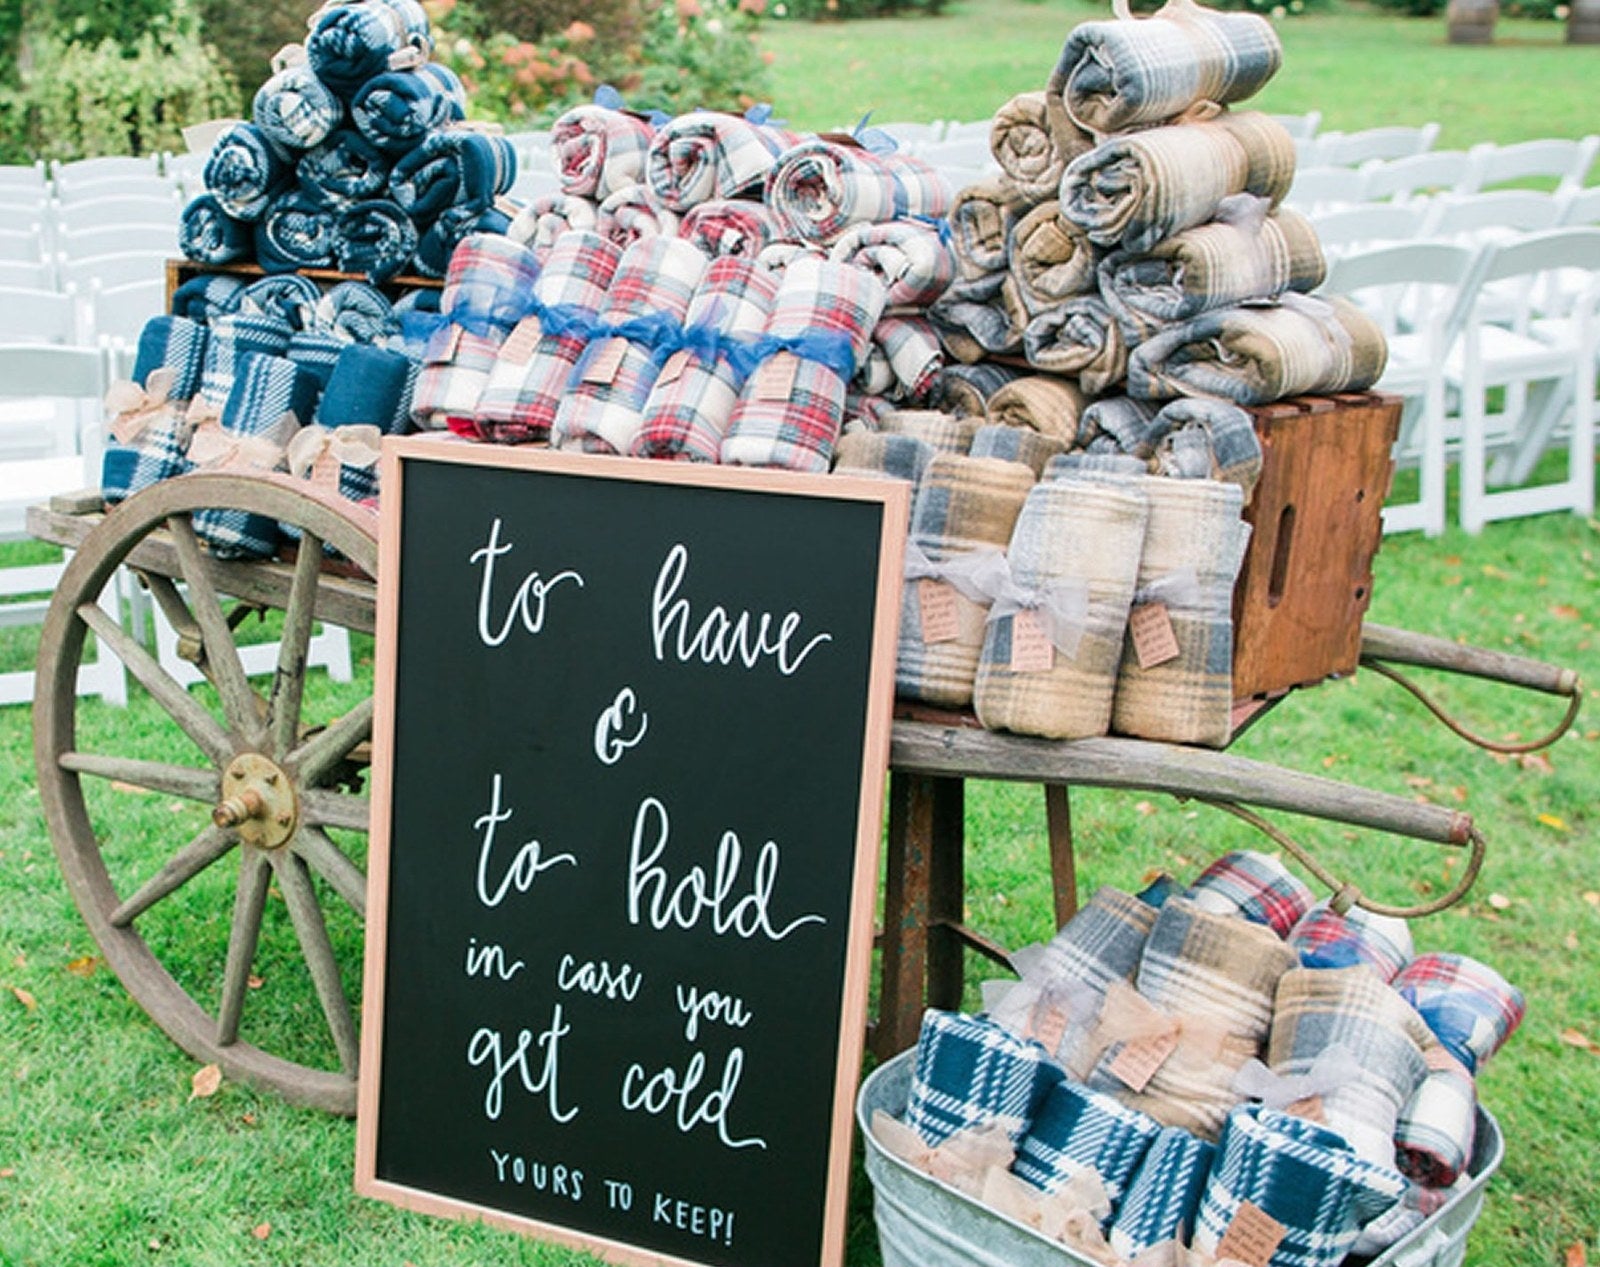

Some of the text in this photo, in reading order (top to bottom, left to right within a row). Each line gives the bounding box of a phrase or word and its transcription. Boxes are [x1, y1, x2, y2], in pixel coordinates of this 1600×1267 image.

[469, 518, 584, 647] to
[651, 543, 833, 675] have
[594, 687, 648, 765] &
[473, 773, 827, 941] to hold
[466, 938, 752, 1042] in case you
[467, 1003, 767, 1149] get cold
[490, 1149, 735, 1247] YOURS TO KEEP!
